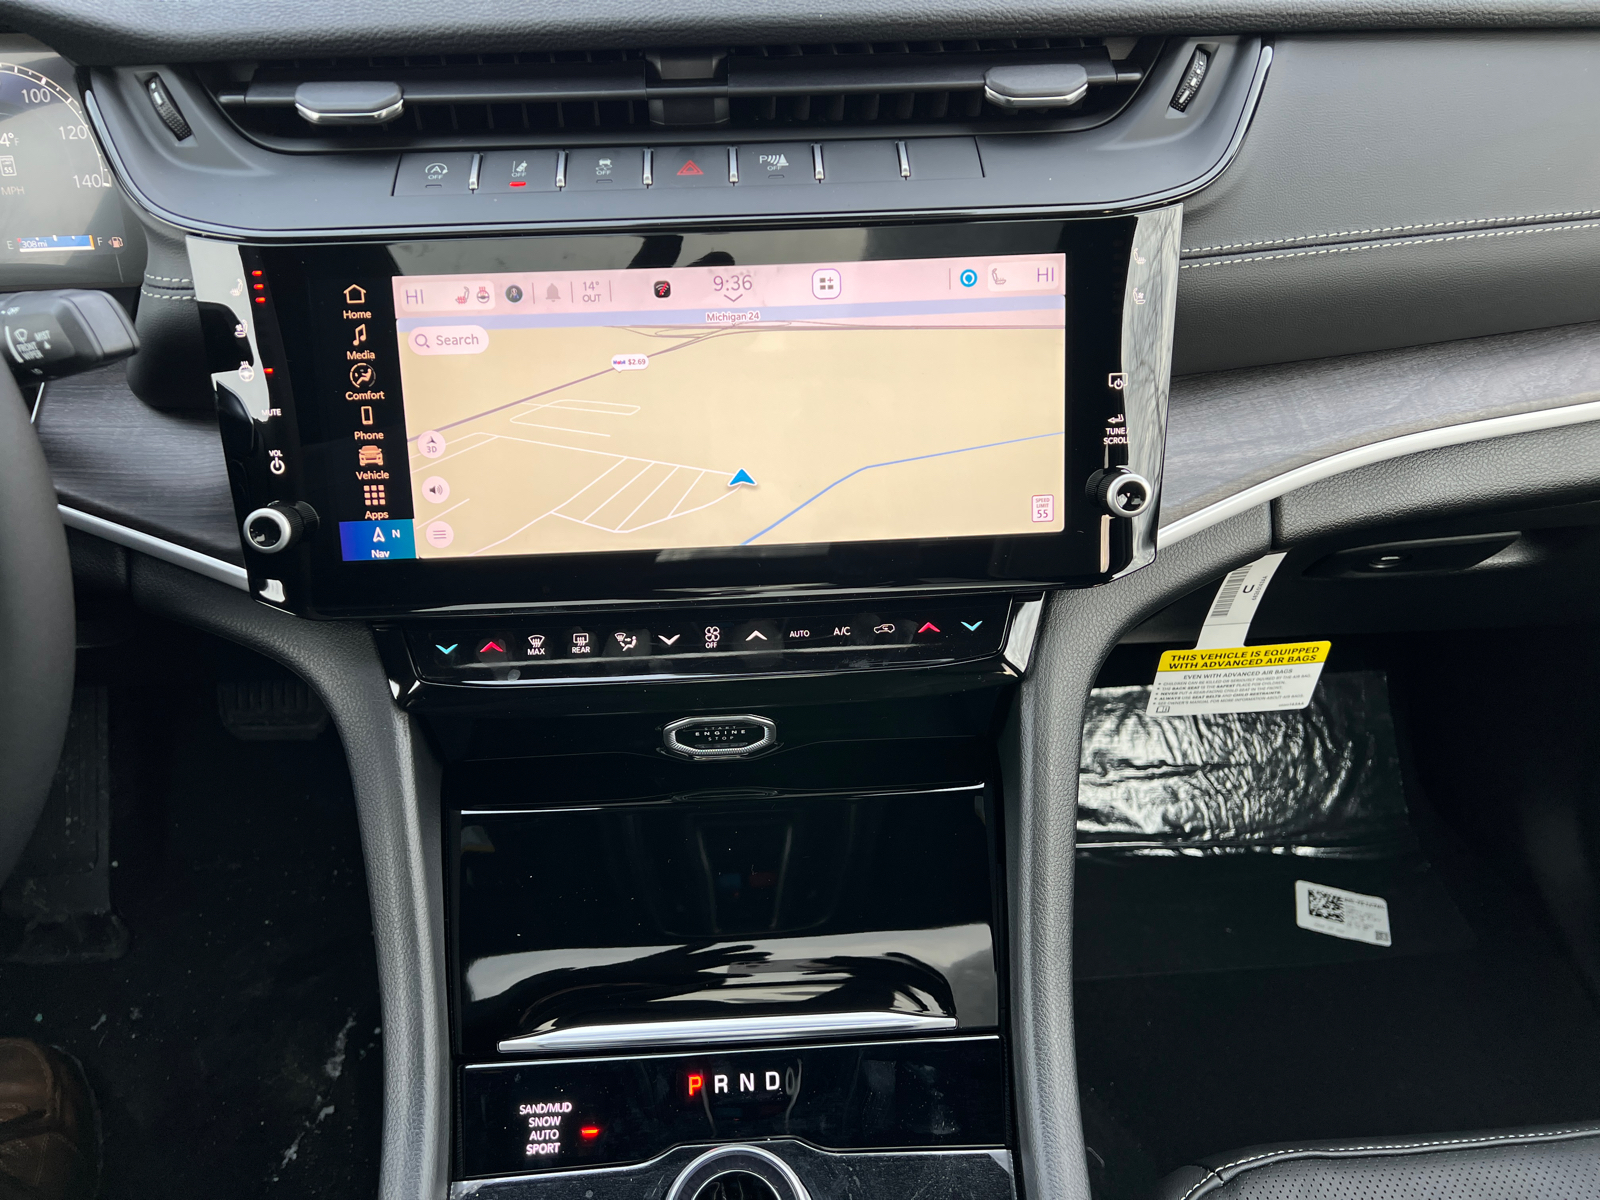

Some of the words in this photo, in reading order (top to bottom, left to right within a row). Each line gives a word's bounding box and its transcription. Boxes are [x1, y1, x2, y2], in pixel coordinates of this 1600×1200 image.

[21, 88, 50, 104] 100
[59, 125, 87, 140] 120
[73, 174, 101, 188] 140
[1, 186, 25, 195] MPH
[7, 241, 14, 250] E
[97, 238, 103, 246] F
[1037, 267, 1055, 283] HI
[582, 281, 600, 292] 14°
[713, 274, 753, 292] 9:36
[405, 289, 424, 305] HI
[582, 294, 602, 302] OUT
[343, 310, 372, 320] Home
[706, 312, 746, 323] Michigan
[748, 312, 760, 321] 24
[436, 334, 480, 346] Search
[346, 350, 376, 360] Media
[346, 390, 385, 400] Comfort
[262, 408, 282, 416] MUTE
[354, 430, 384, 440] Phone
[1103, 436, 1130, 444] SCROLL
[426, 446, 438, 454] 3D
[356, 470, 390, 480] Vehicle
[364, 510, 389, 520] Apps
[1036, 510, 1048, 518] 55
[392, 529, 400, 538] N
[371, 550, 390, 559] Nav
[790, 629, 810, 638] AUTO
[834, 626, 851, 636] A/C
[572, 646, 590, 654] REAR
[1200, 652, 1248, 660] VEHICLE
[1264, 646, 1320, 656] EQUIPPED
[1201, 658, 1263, 668] ADVANCED
[1287, 654, 1317, 662] BAGS
[689, 1075, 702, 1096] P
[714, 1074, 728, 1094] R
[740, 1073, 755, 1092] N
[765, 1071, 780, 1090] D
[519, 1102, 572, 1115] SAND/MUD
[528, 1116, 561, 1128] SNOW
[529, 1128, 560, 1140] AUTO
[526, 1142, 560, 1155] SPORT
